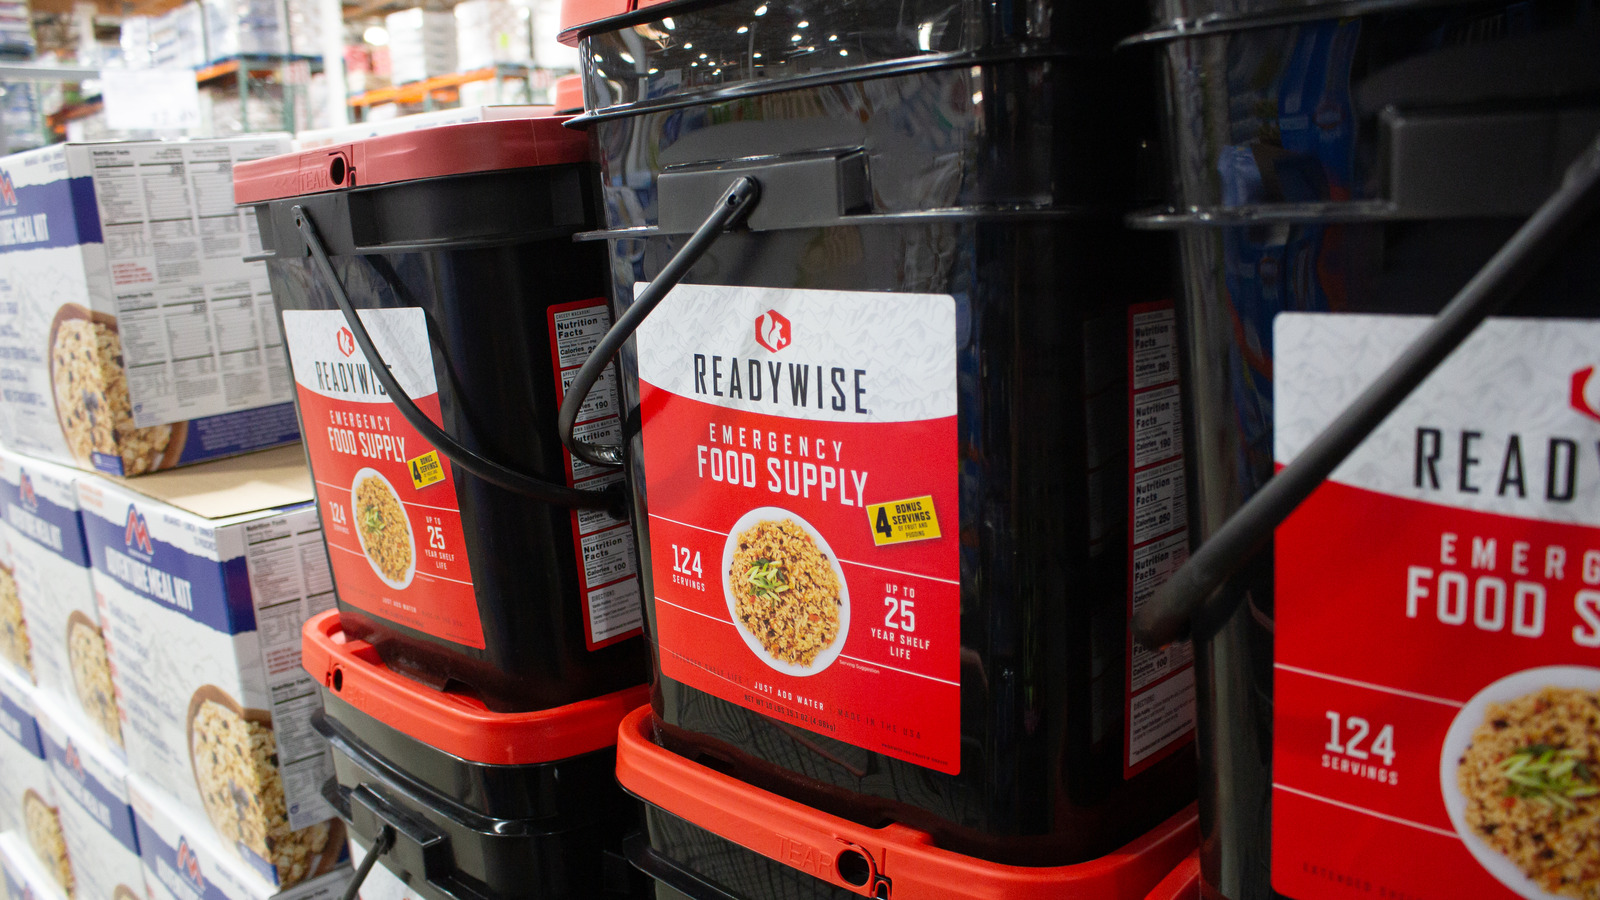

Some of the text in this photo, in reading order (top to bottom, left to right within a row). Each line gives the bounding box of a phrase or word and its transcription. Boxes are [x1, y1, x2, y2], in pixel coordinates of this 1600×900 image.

[300, 169, 329, 191] TEAR
[557, 317, 598, 331] Nutrition
[1135, 324, 1169, 338] Nutrition
[558, 329, 583, 339] Facts
[560, 347, 584, 355] Calories
[1135, 338, 1156, 349] Facts
[693, 353, 868, 414] READYWISE
[595, 400, 608, 410] 190
[1136, 401, 1170, 417] Nutrition
[329, 410, 391, 432] EMERGENCY
[1136, 416, 1157, 429] Facts
[328, 426, 358, 456] FOOD
[359, 431, 407, 463] SUPPLY
[709, 423, 842, 462] EMERGENCY
[412, 461, 422, 483] 4
[697, 445, 868, 508] FOOD SUPPLY
[1136, 477, 1170, 495] Nutrition
[895, 501, 922, 514] BONUS
[1136, 492, 1158, 507] Facts
[329, 501, 347, 525] 124
[425, 516, 442, 526] UP TO
[580, 513, 603, 522] Calories
[892, 511, 931, 525] SERVINGS
[875, 506, 893, 538] 4
[904, 523, 918, 531] FRUIT
[426, 525, 446, 550] 25
[584, 537, 623, 553] Nutrition
[425, 549, 455, 562] YEAR SHELF
[585, 550, 609, 562] Facts
[671, 544, 703, 578] 124
[1135, 551, 1169, 572] Nutrition
[435, 561, 448, 570] LIFE
[587, 562, 627, 577] Calories 100
[1135, 567, 1156, 582] Facts
[672, 574, 706, 592] SERVINGS
[886, 583, 915, 598] UP TO
[1406, 565, 1546, 639] FOOD
[884, 596, 915, 632] 25
[871, 627, 930, 650] YEAR SHELF
[890, 646, 911, 660] LIFE
[727, 671, 742, 684] LIFE
[754, 681, 773, 694] JUST
[777, 689, 792, 701] ADD
[796, 694, 824, 711] WATER
[837, 708, 861, 722] MADE
[866, 716, 875, 727] IN
[880, 720, 897, 733] THE
[902, 727, 921, 740] USA
[755, 698, 764, 707] WT
[774, 704, 785, 714] LBS
[1325, 710, 1396, 767] 124
[1321, 754, 1399, 786] SERVINGS
[776, 833, 834, 879] TEAR
